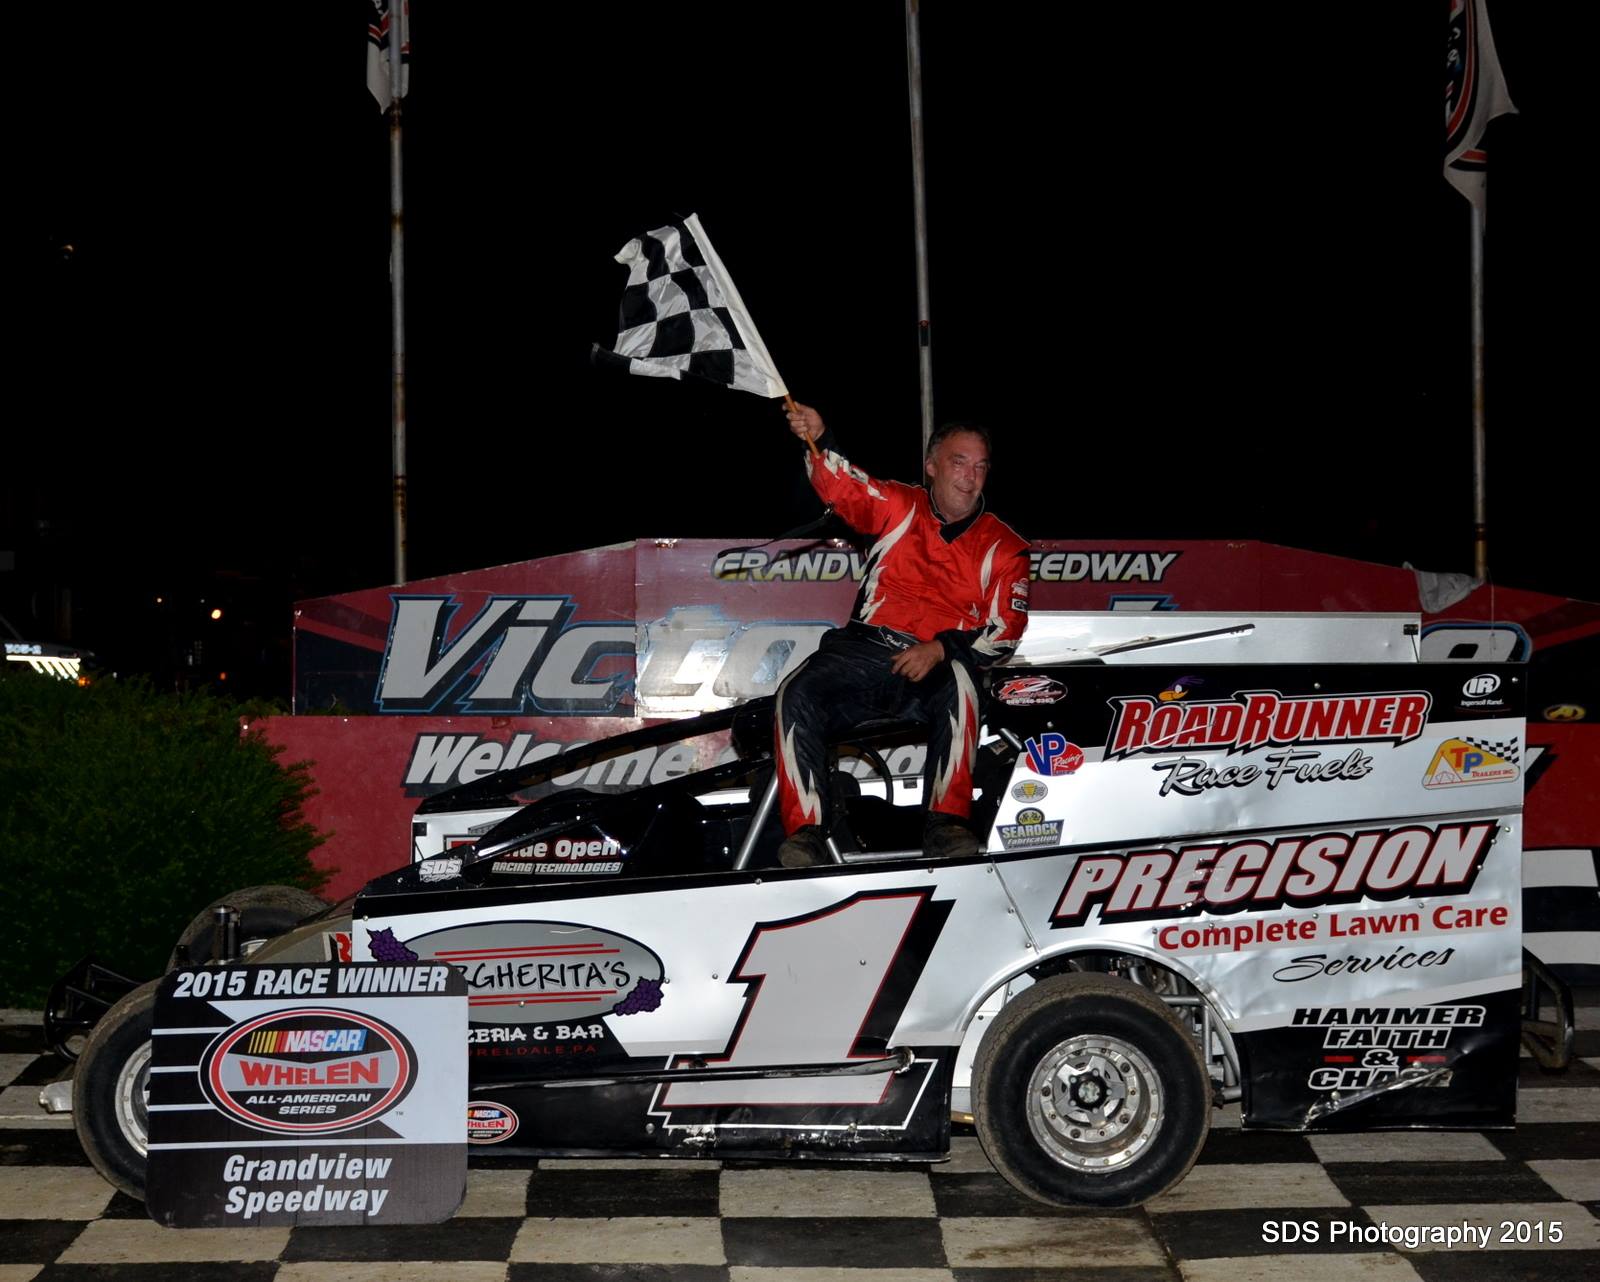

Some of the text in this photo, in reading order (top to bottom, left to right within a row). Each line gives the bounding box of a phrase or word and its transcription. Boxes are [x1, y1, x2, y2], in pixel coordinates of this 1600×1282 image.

[1024, 732, 1066, 776] VP
[1053, 753, 1083, 773] Racing
[1450, 747, 1484, 774] TP
[1152, 749, 1373, 798] Race Fuels
[1002, 822, 1059, 839] SEAROCK
[555, 838, 617, 860] Open
[1050, 820, 1500, 928] PRECISION
[1157, 904, 1509, 952] Complete Lawn Care
[1273, 944, 1455, 982] Services
[173, 966, 449, 998] 2015 RACE WINNER
[658, 889, 935, 1112] 1
[1289, 1005, 1486, 1027] HAMMER
[285, 1030, 367, 1052] NASCAR
[532, 1026, 549, 1040] &
[555, 1024, 604, 1040] BAR
[1323, 1027, 1452, 1048] FAITH
[239, 1057, 380, 1087] WHELEN
[1362, 1049, 1400, 1068] &
[246, 1093, 371, 1105] ALL-AMERICAN
[278, 1105, 337, 1115] SERIES
[223, 1154, 392, 1182] Grandview
[224, 1185, 388, 1219] Speedway
